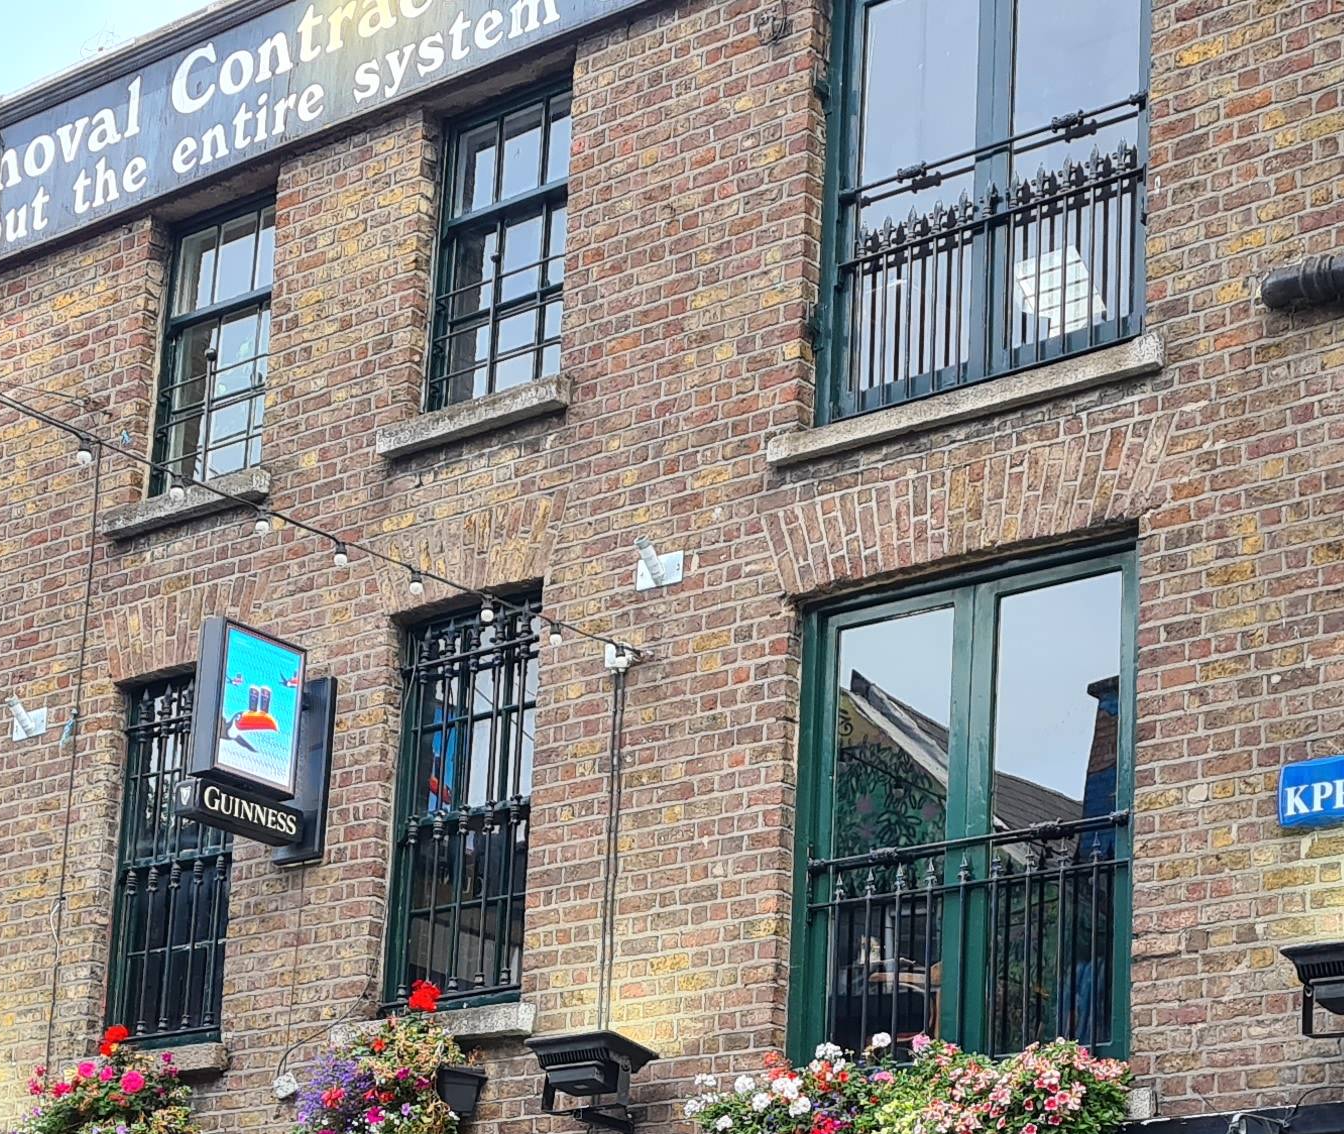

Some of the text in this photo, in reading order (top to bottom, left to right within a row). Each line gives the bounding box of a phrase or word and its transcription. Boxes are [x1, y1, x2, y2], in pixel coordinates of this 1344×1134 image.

[72, 154, 147, 216] the
[172, 80, 325, 176] entire
[353, 0, 561, 104] system
[204, 785, 298, 836] GUINNESS
